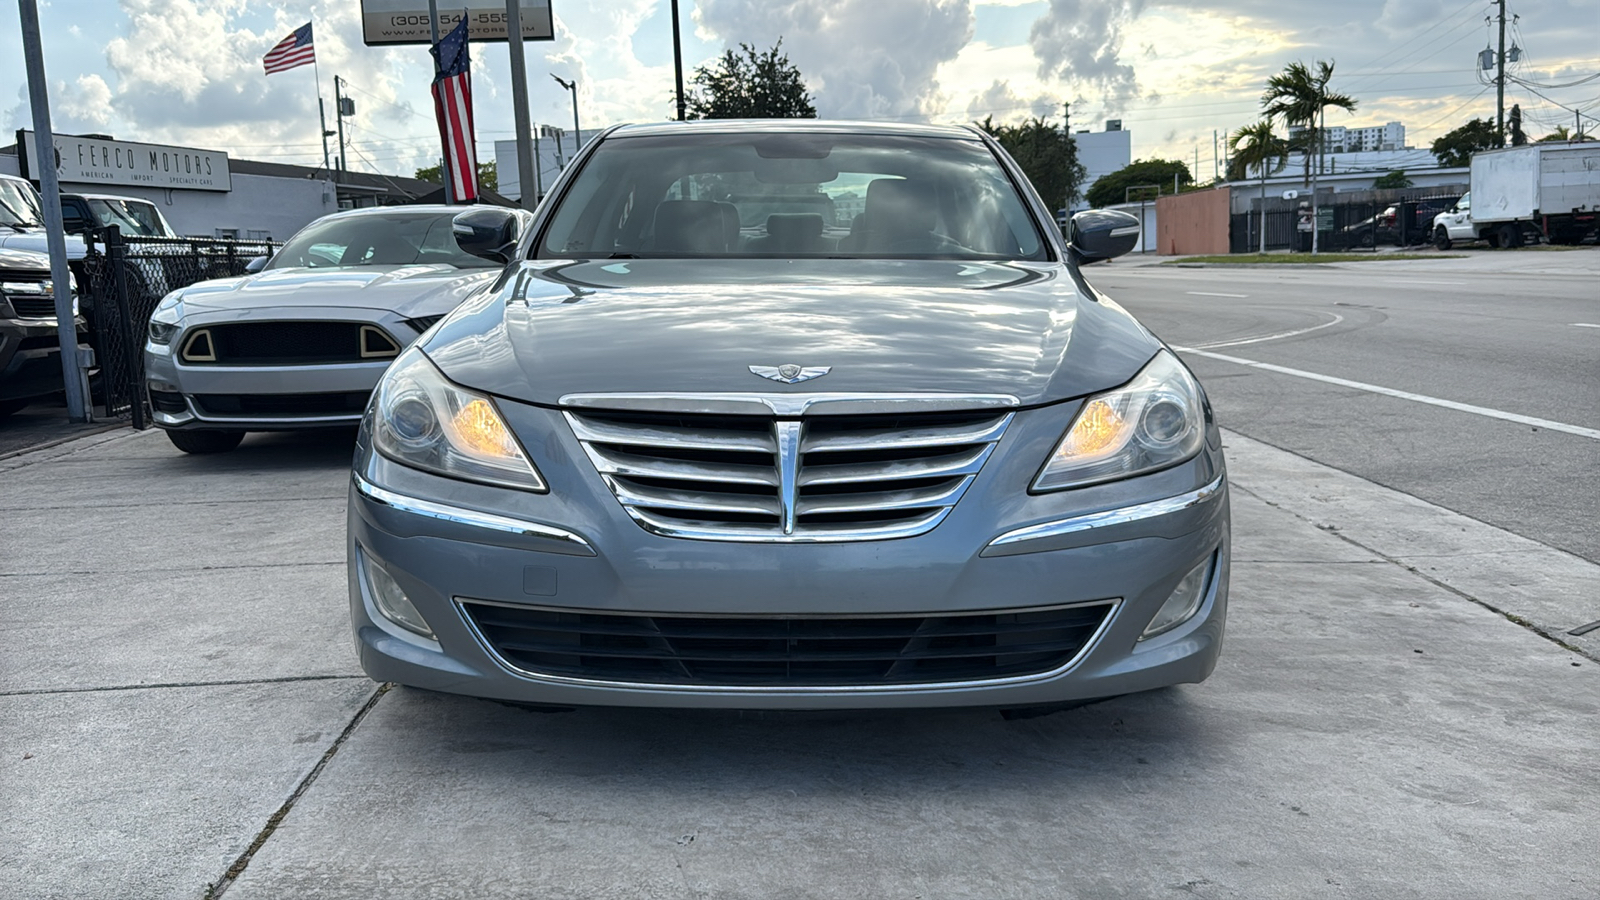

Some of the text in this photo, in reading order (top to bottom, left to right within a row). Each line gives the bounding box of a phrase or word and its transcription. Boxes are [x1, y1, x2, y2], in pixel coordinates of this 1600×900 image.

[391, 15, 432, 27] (305
[78, 144, 134, 169] FERCO
[149, 150, 212, 176] MOTORS
[81, 171, 114, 179] AMERICAN
